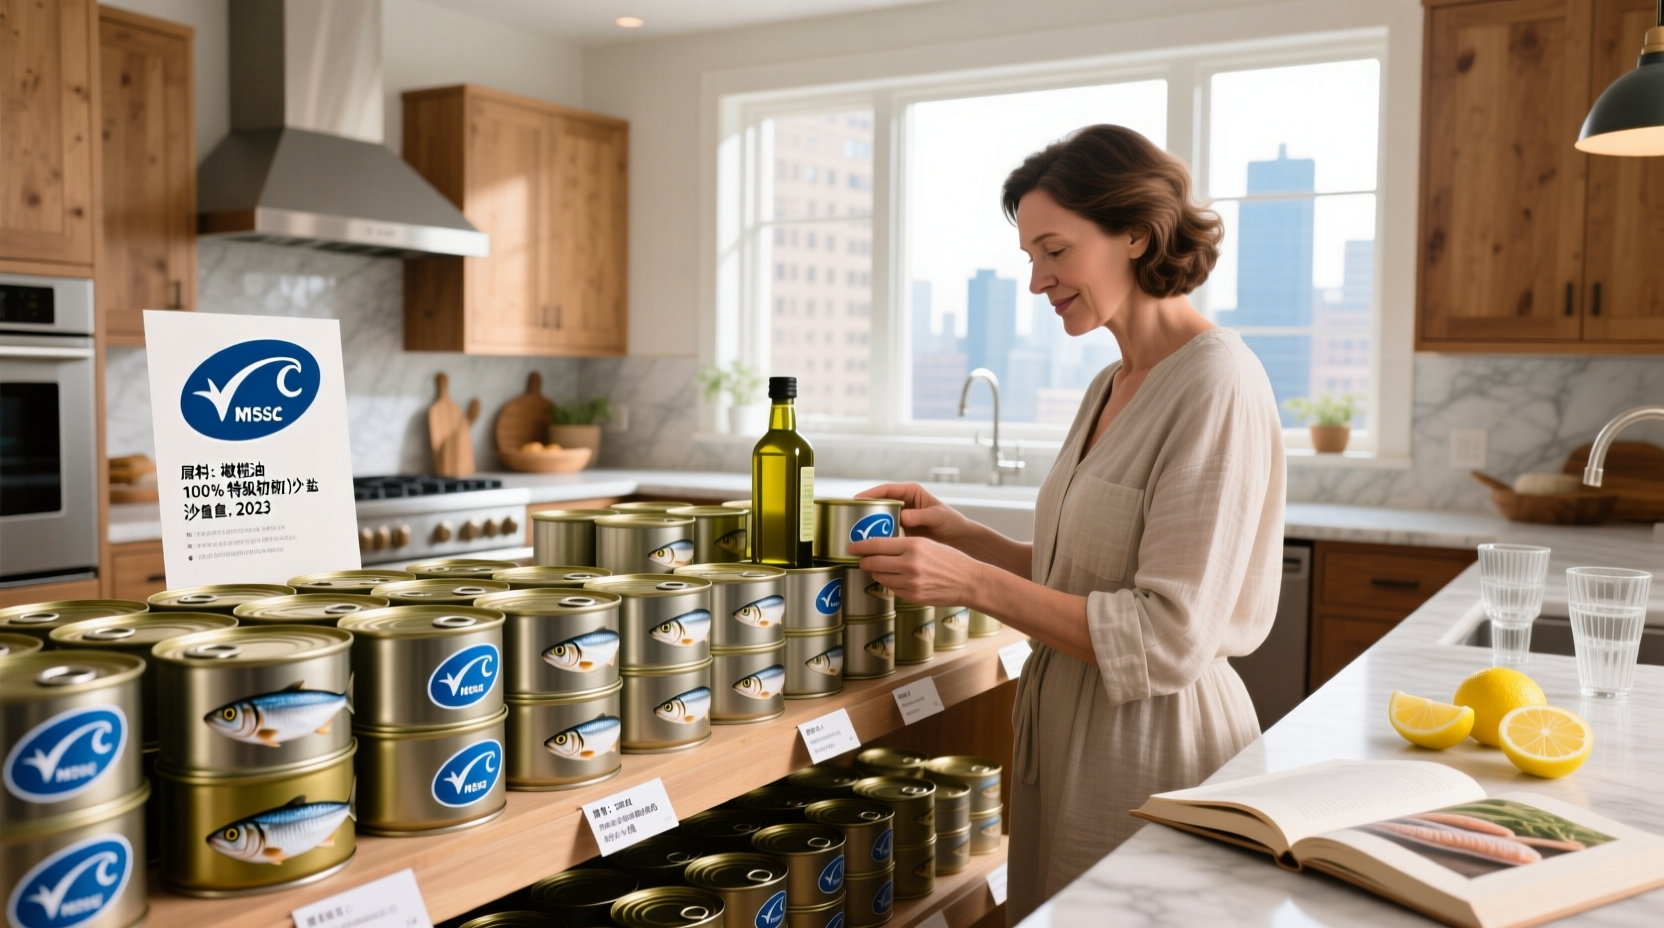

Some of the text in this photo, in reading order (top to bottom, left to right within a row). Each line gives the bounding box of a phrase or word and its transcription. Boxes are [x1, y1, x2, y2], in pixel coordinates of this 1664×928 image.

[235, 406, 283, 422] MSSC
[183, 484, 224, 498] 100%
[236, 500, 271, 516] 2023
